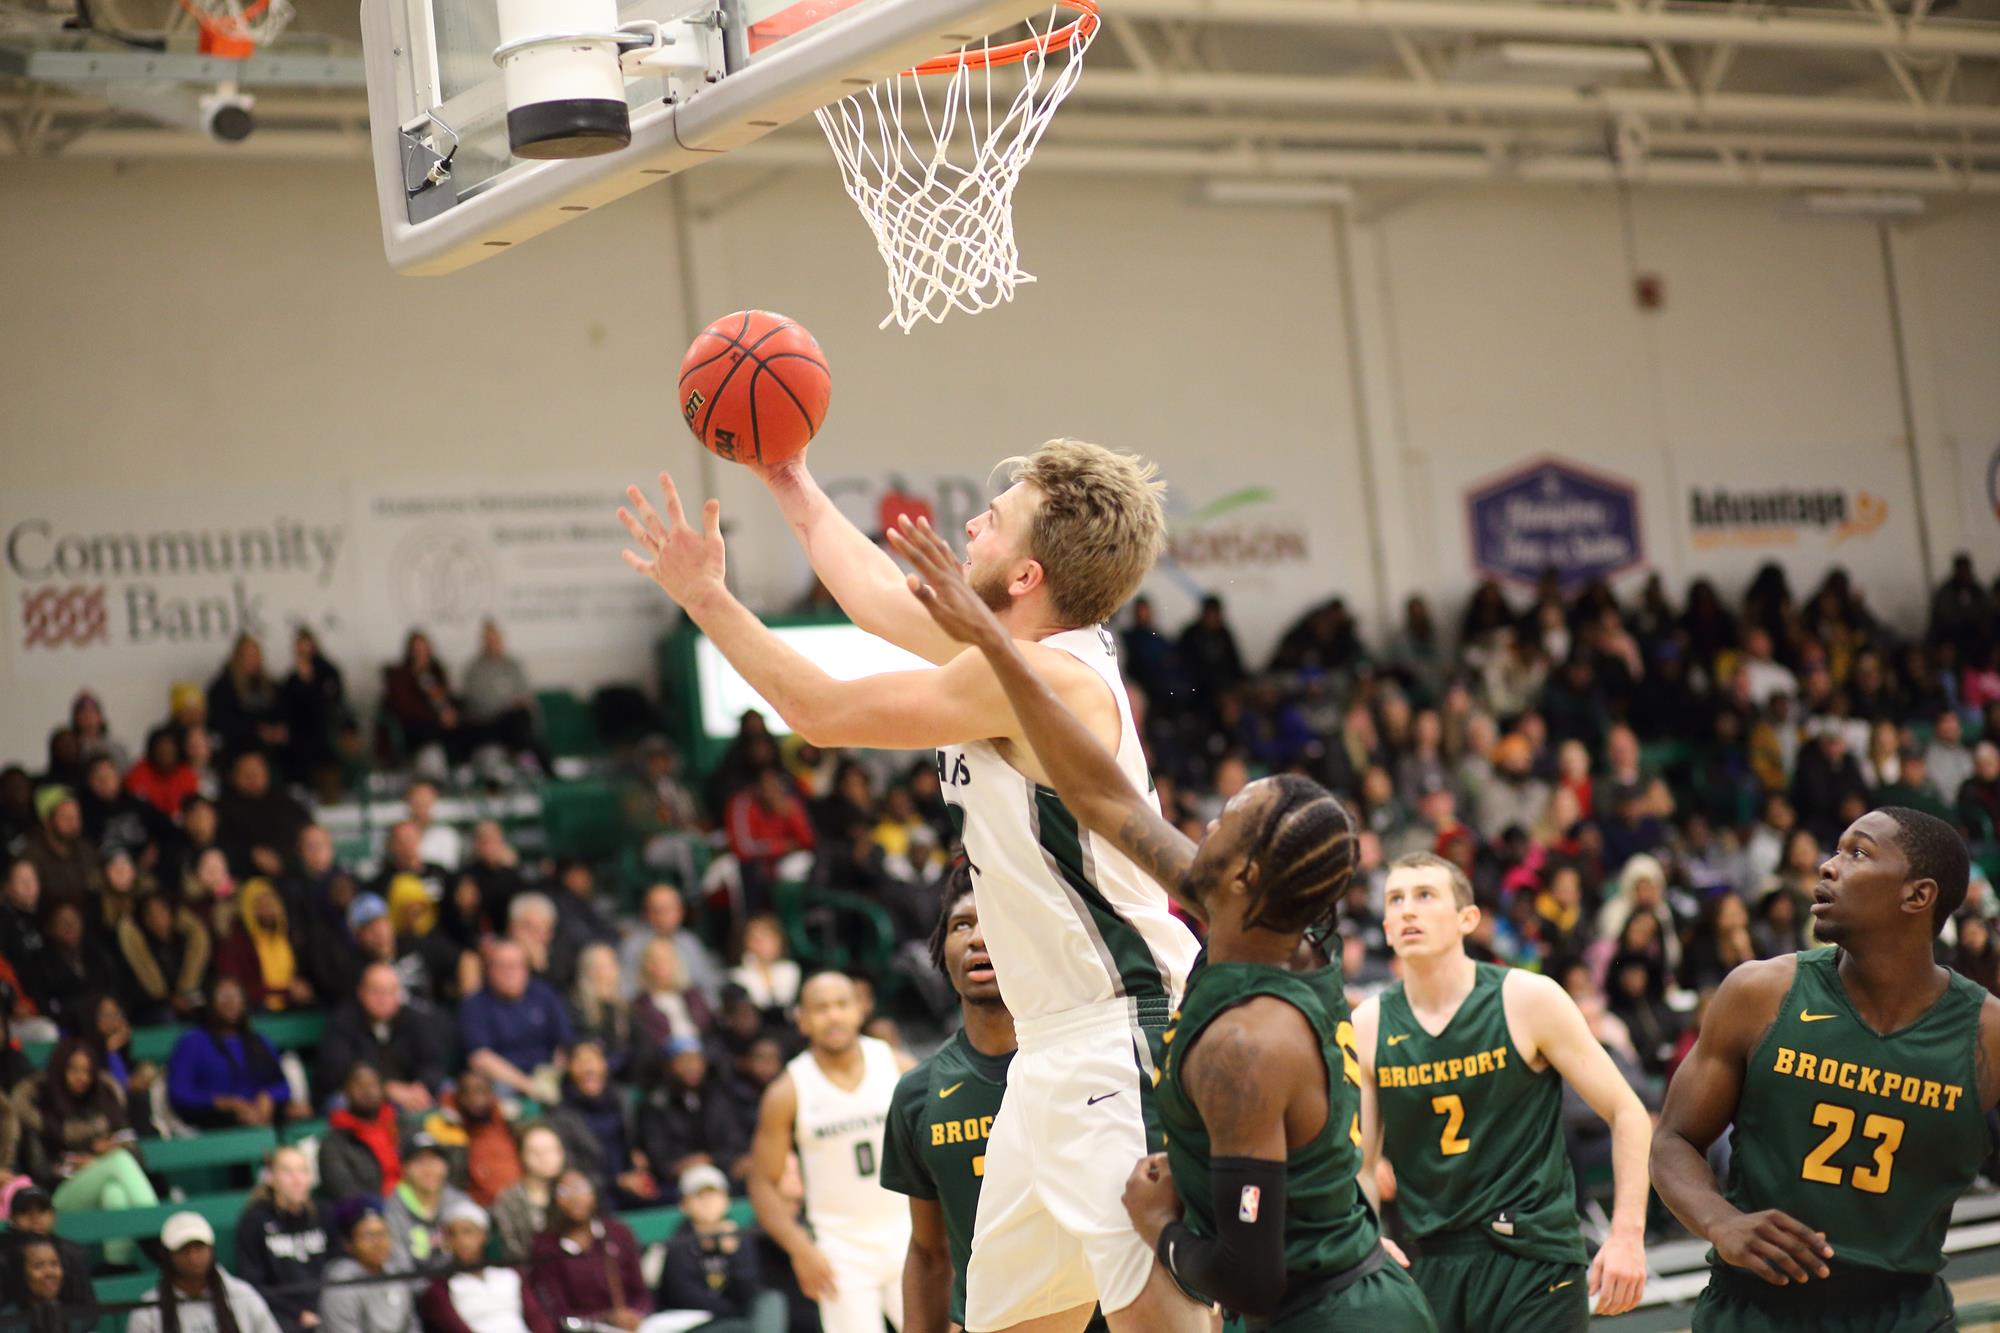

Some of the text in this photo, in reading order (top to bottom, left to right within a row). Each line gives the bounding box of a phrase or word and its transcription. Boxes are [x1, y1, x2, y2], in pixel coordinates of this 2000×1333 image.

[1690, 488, 1846, 529] Advantage
[6, 517, 343, 584] Community
[124, 582, 268, 643] Bank
[1378, 1046, 1507, 1088] BROCKPORT
[1773, 1046, 1963, 1111] BROCKPORT
[930, 1115, 995, 1146] BROC
[1431, 1094, 1470, 1156] 2
[1802, 1102, 1905, 1194] 23
[854, 1140, 876, 1177] 0
